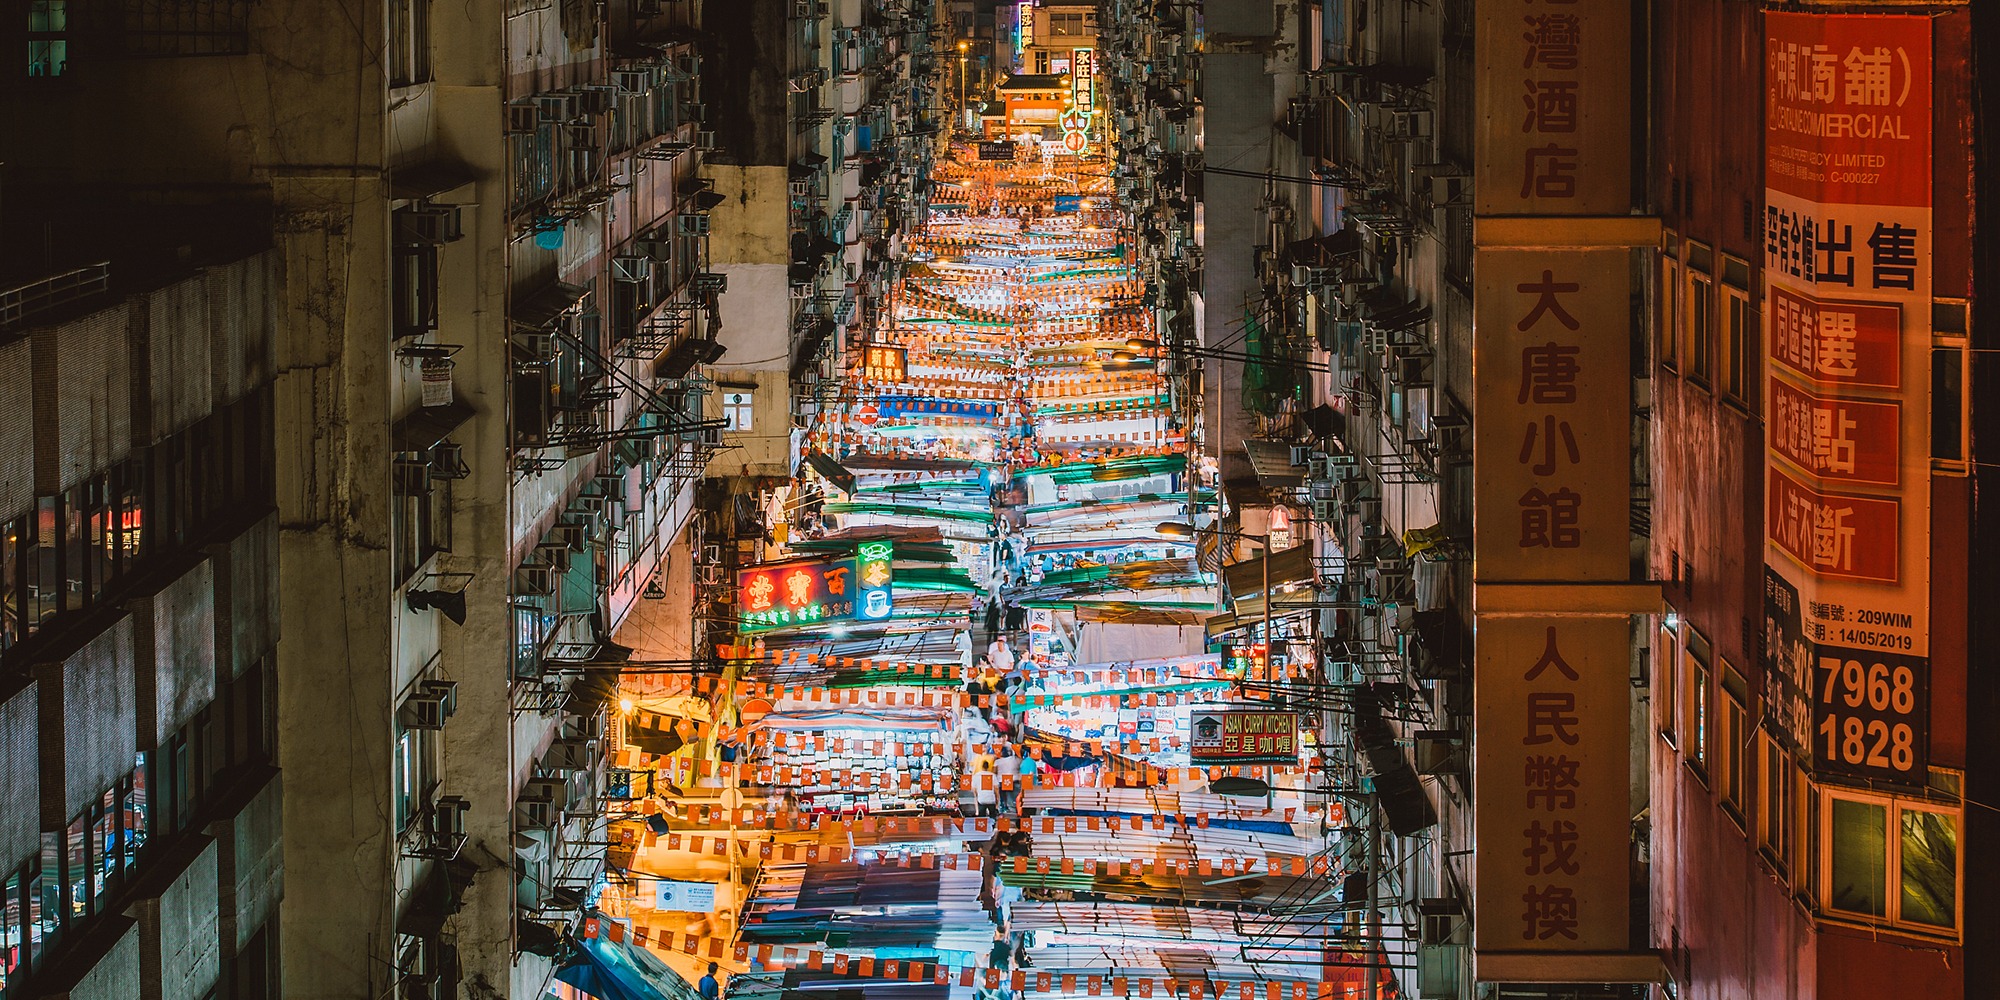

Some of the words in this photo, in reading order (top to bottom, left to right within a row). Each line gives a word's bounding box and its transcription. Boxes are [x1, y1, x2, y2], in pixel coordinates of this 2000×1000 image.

[1520, 0, 1580, 199] 灣酒店
[1830, 171, 1880, 184] C-000227
[1834, 154, 1885, 168] LIMITED
[1777, 295, 1858, 377] 同區首選
[1517, 269, 1581, 549] 大唐小館
[1776, 480, 1856, 571] 人流不斷
[1839, 628, 1912, 650] 14/05/2019
[1857, 609, 1912, 629] 209WIM
[1819, 656, 1914, 715] 7968
[1224, 735, 1291, 753] 亞星咖喱
[1225, 715, 1242, 733] ASIAN
[1244, 715, 1264, 733] CURRY
[1266, 715, 1291, 733] KITCHEN
[1820, 713, 1914, 772] 1828
[1522, 626, 1580, 941] 人民幣找換
